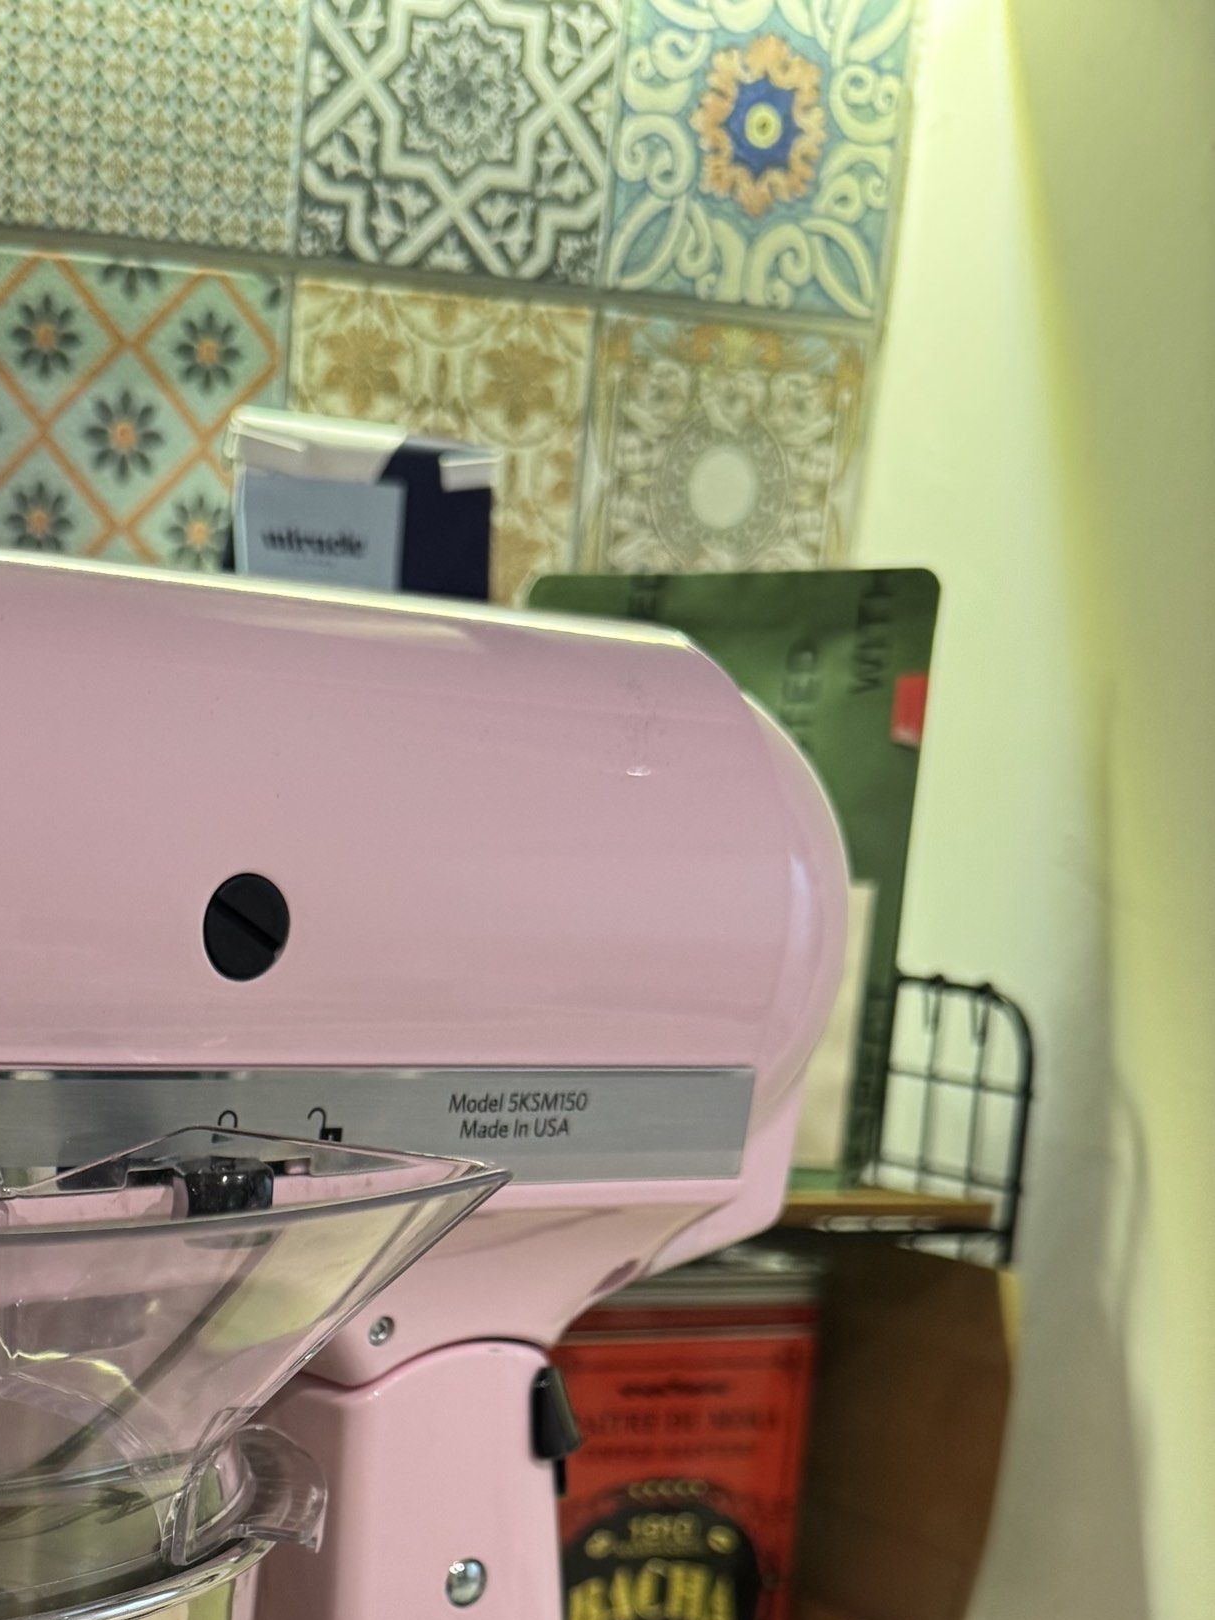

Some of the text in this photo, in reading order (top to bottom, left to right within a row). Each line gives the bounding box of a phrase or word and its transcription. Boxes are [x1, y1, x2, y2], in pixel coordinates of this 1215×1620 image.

[448, 1091, 589, 1114] Model 5KSM150
[460, 1117, 570, 1139] Made In USA
